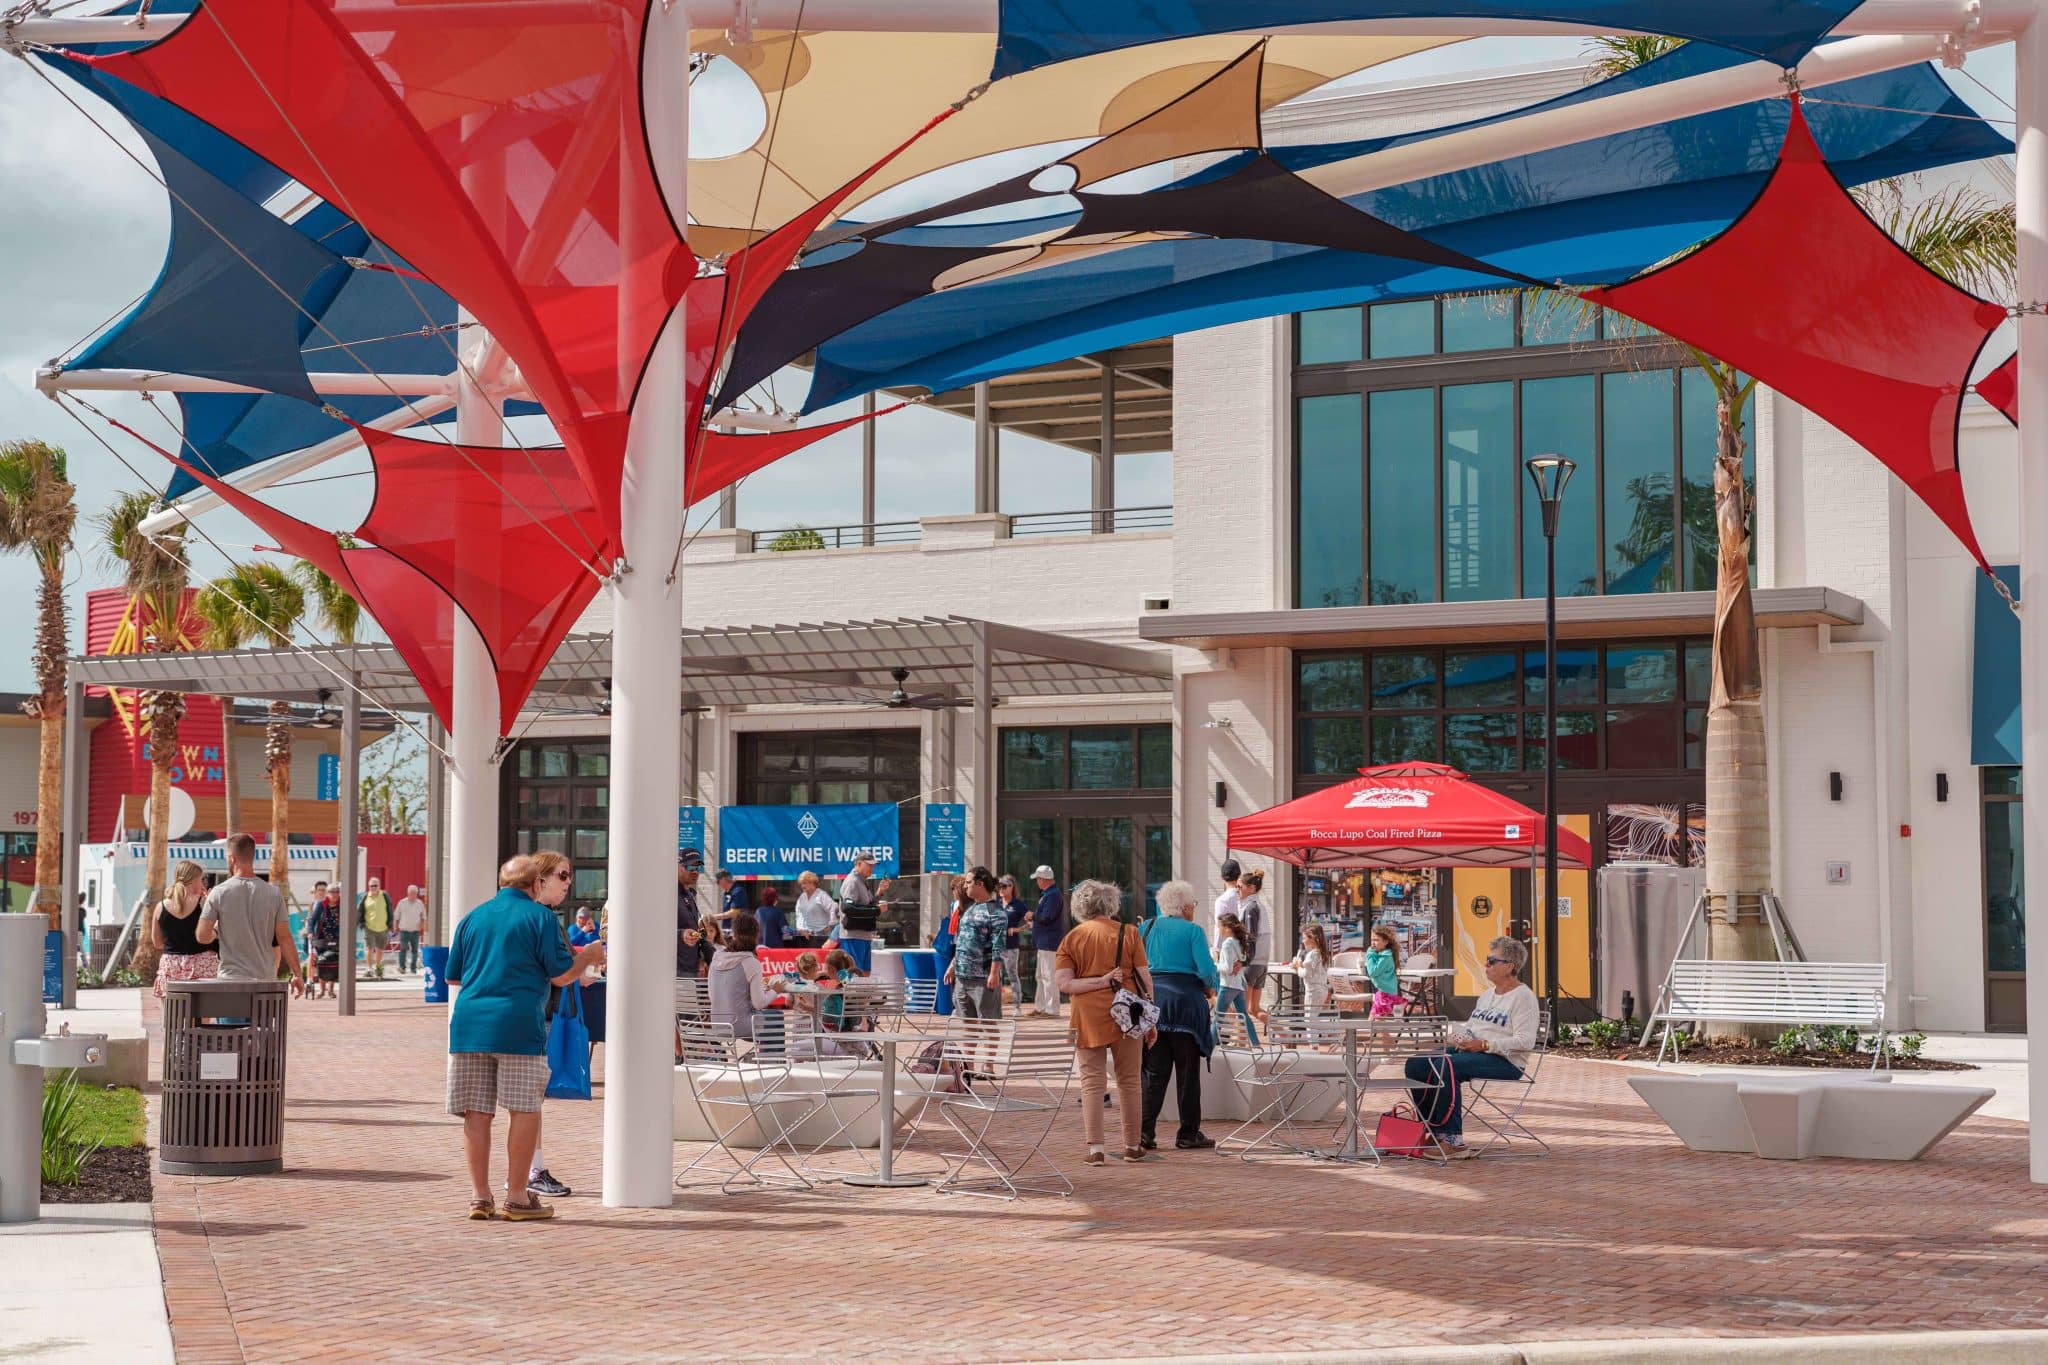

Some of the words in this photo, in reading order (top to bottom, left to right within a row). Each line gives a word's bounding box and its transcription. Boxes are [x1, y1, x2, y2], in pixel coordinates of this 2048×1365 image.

[143, 743, 219, 762] DWN
[1310, 829, 1338, 839] Bocca
[1340, 828, 1364, 840] Lupo
[1366, 828, 1388, 839] Coal
[1390, 828, 1415, 838] Fired
[1417, 828, 1442, 838] Pizza
[726, 848, 767, 863] BEER
[779, 847, 823, 863] WINE
